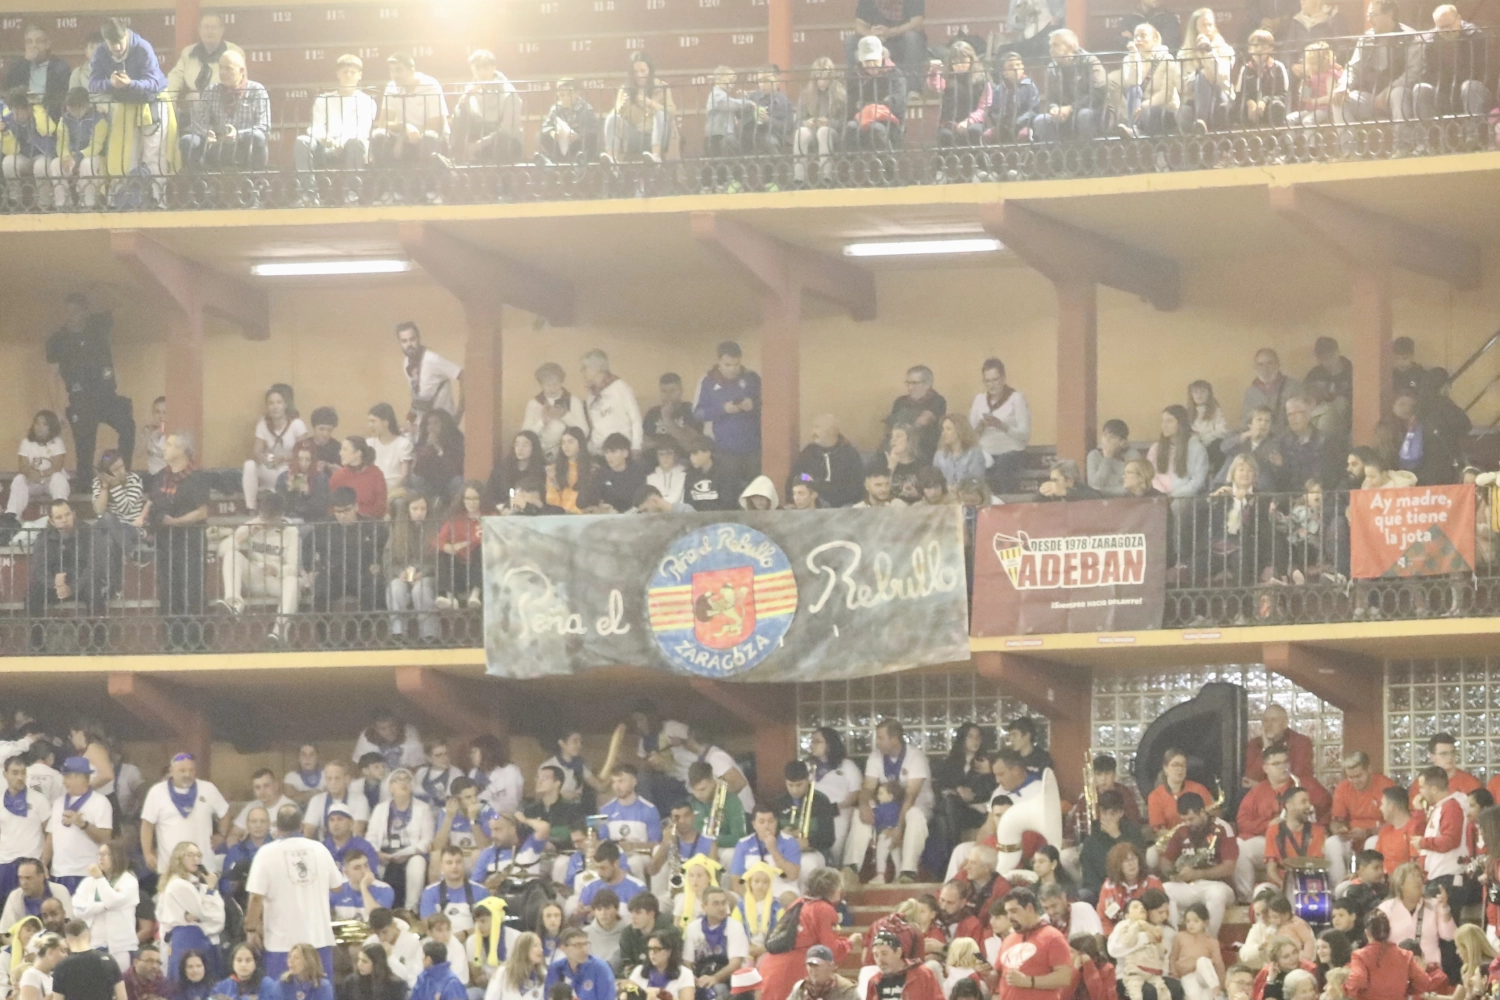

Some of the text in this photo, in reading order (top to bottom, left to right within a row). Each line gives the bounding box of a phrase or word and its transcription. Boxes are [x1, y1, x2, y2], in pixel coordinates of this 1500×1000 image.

[56, 17, 78, 29] 108
[732, 34, 755, 45] 120
[1370, 489, 1452, 513] Ay madre,
[1374, 508, 1448, 528] qué tiene
[1031, 536, 1144, 552] DESDE 1978 ZARAGOZA
[1384, 528, 1432, 550] la jota
[659, 549, 701, 582] Peña
[1017, 549, 1144, 588] ADEBAN
[504, 539, 960, 639] Peña el Rebullo
[673, 634, 771, 671] ZARAGOZA
